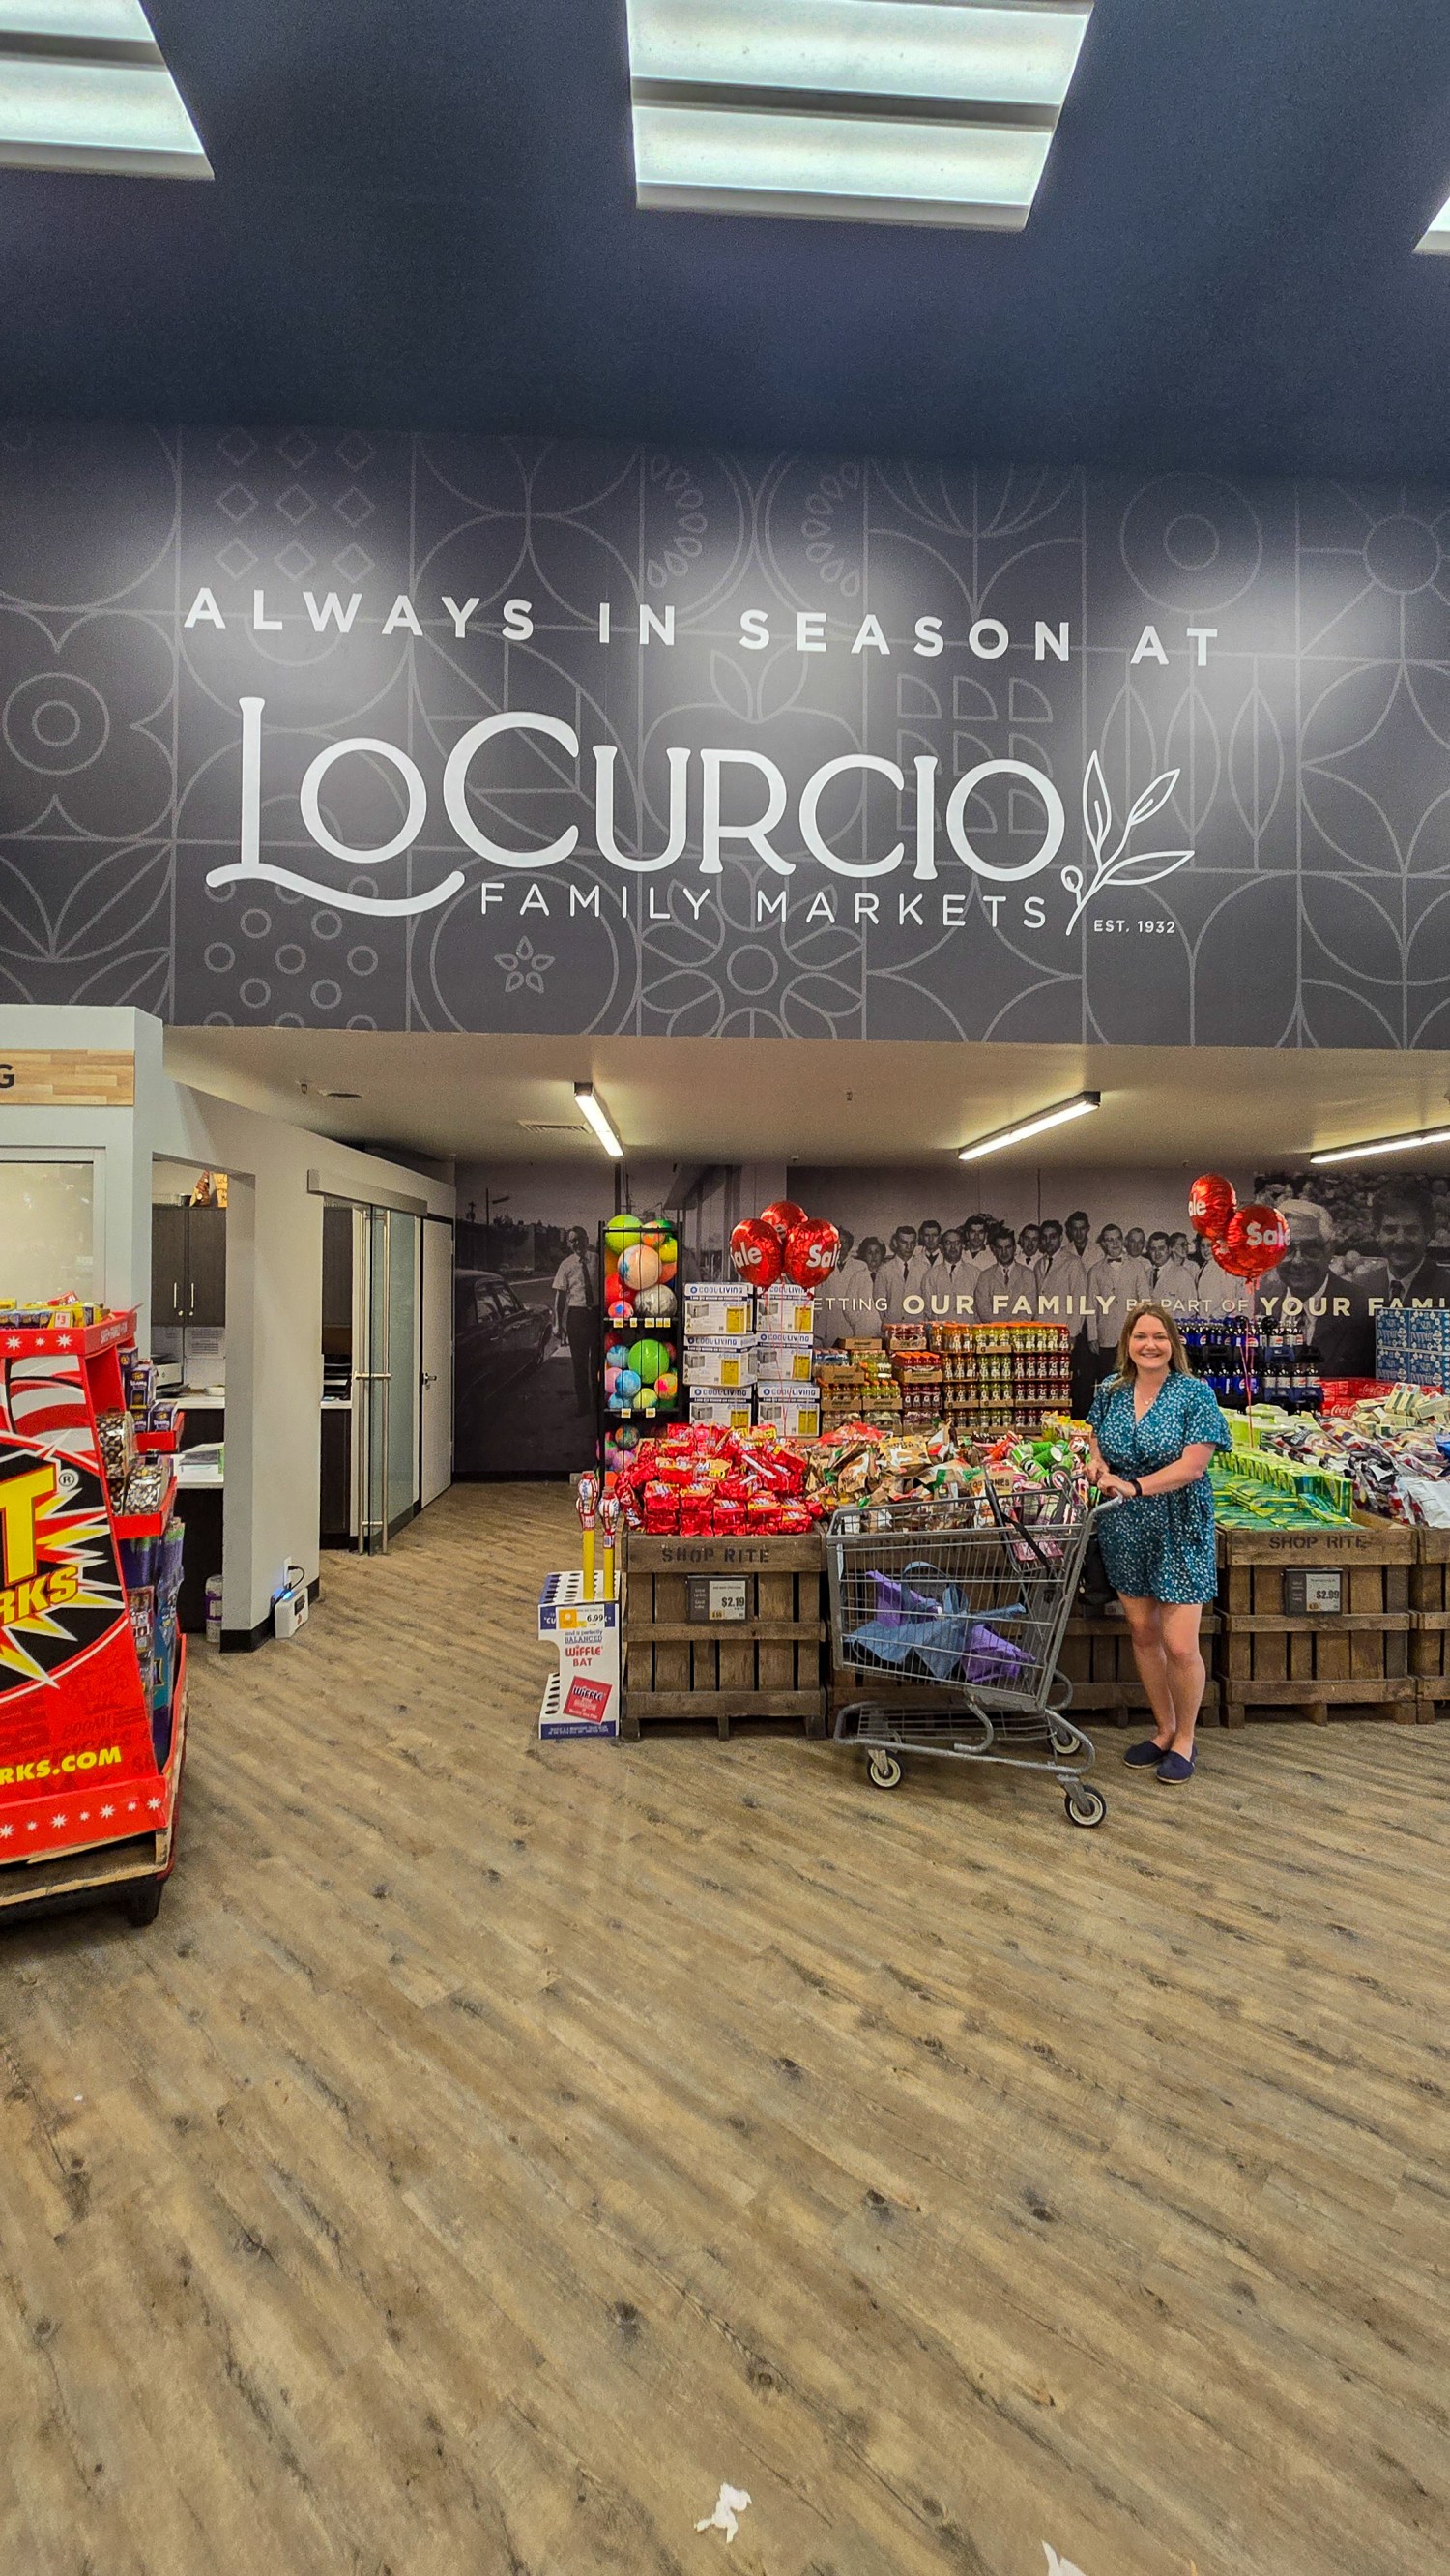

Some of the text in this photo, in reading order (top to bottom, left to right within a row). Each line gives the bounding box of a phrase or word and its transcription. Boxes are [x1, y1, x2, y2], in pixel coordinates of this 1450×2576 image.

[184, 586, 1219, 667] ALWAYS IN SEASON AT
[480, 881, 1048, 929] FAMILY MARKETS
[1093, 920, 1176, 935] EST. 1932
[902, 1294, 974, 1316] OUR
[992, 1294, 1116, 1316] FAMILY
[1160, 1298, 1212, 1312] PART
[1221, 1299, 1249, 1313] OF
[1260, 1296, 1351, 1317] YOUR
[1269, 1535, 1368, 1549] SHOP RITE
[662, 1547, 770, 1563] SHOP RITE
[1316, 1590, 1340, 1599] $2.99
[721, 1596, 745, 1608] $2.19
[565, 1635, 603, 1644] BALANCED
[573, 1657, 593, 1667] BAT
